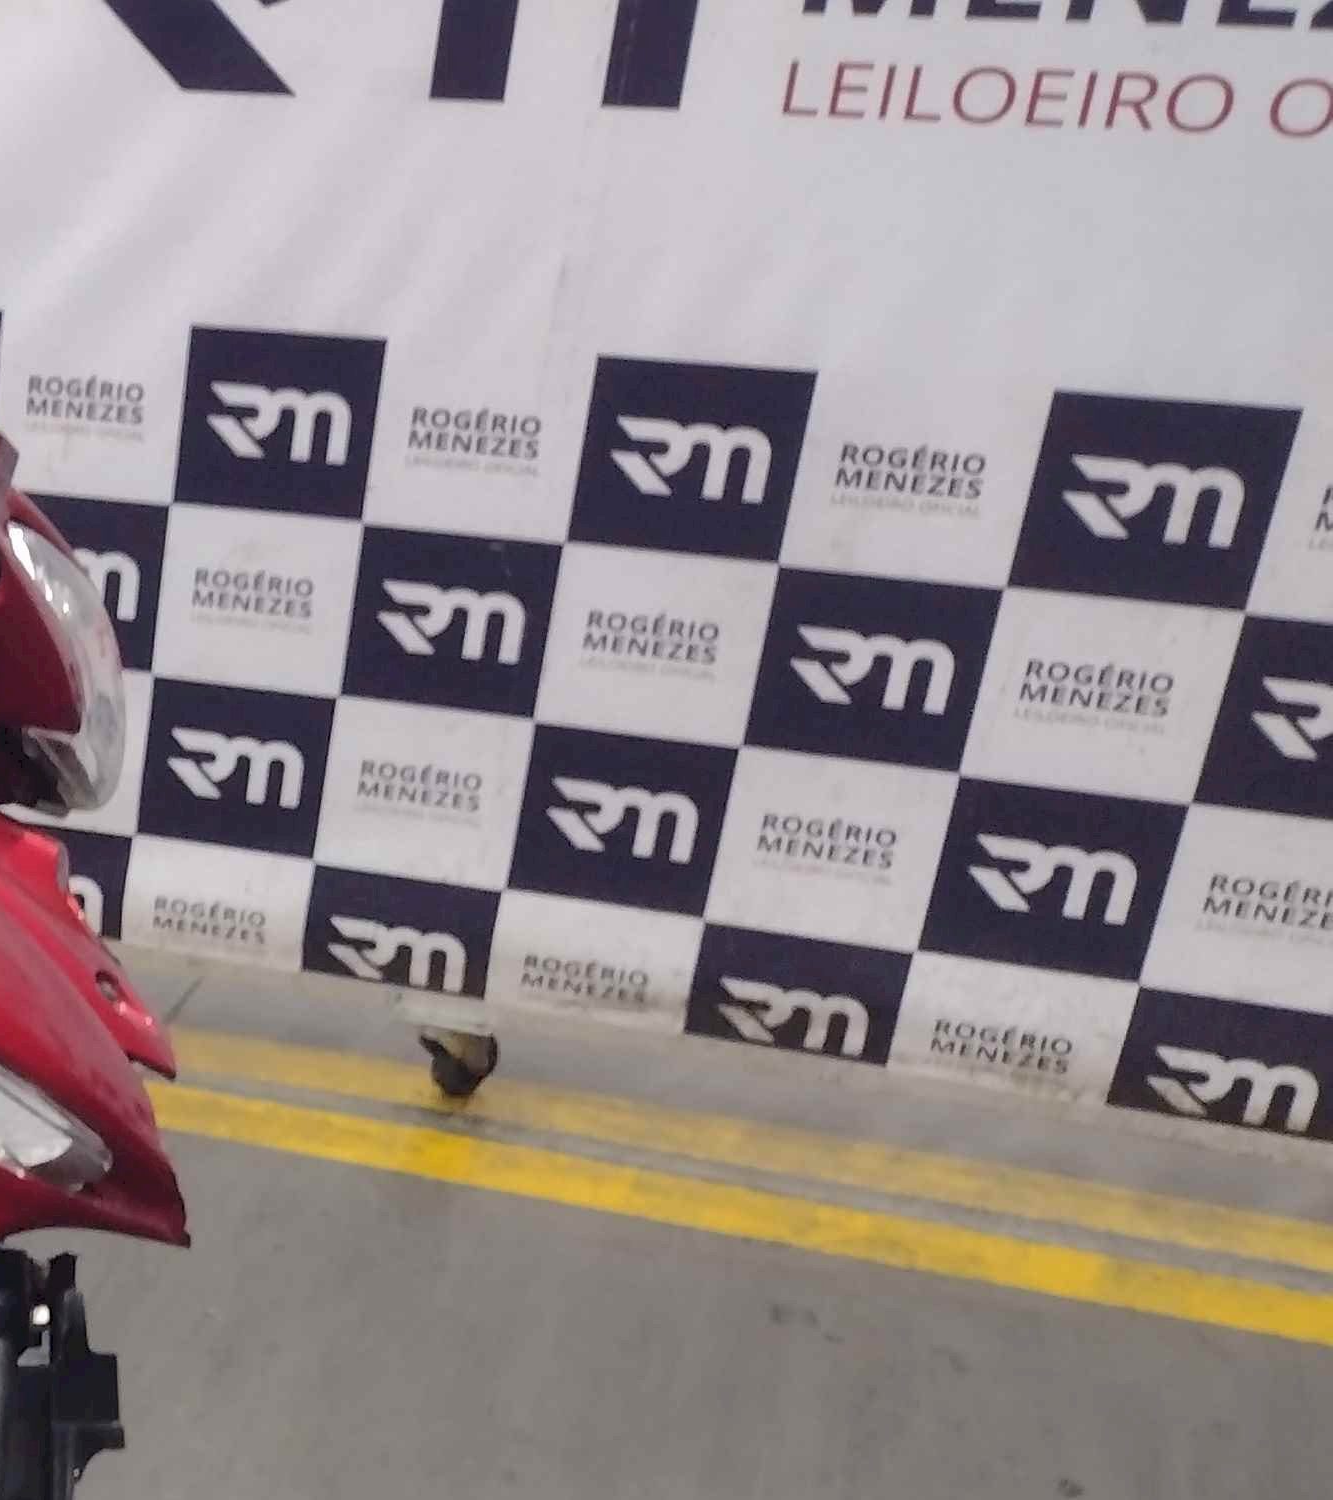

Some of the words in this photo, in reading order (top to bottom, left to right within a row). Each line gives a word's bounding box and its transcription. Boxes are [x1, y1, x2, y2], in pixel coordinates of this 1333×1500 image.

[781, 59, 1234, 133] LEILOEIRO
[28, 375, 145, 405] ROGÉRIO
[26, 396, 143, 425] MENEZES
[411, 407, 542, 438] ROGÉRIO
[408, 428, 539, 459] MENEZES
[839, 443, 986, 477] ROGÉRIO
[834, 466, 982, 499] MENEZES
[194, 568, 314, 599] ROGÉRIO
[192, 588, 312, 619] MENEZES
[586, 610, 720, 644] ROGÉRIO
[582, 631, 716, 665] MENEZES
[1024, 658, 1175, 696] ROGÉRIO
[1018, 681, 1169, 718] MENEZES
[360, 759, 483, 794] ROGÉRIO
[357, 779, 480, 813] MENEZES
[761, 812, 898, 850] ROGÉRIO
[756, 833, 894, 870] MENEZES
[154, 895, 267, 930] ROGÉRIO
[152, 914, 265, 947] MENEZES
[523, 953, 649, 990] ROGÉRIO
[519, 972, 646, 1008] MENEZES
[933, 1017, 1074, 1057] ROGÉRIO
[928, 1037, 1069, 1076] MENEZES
